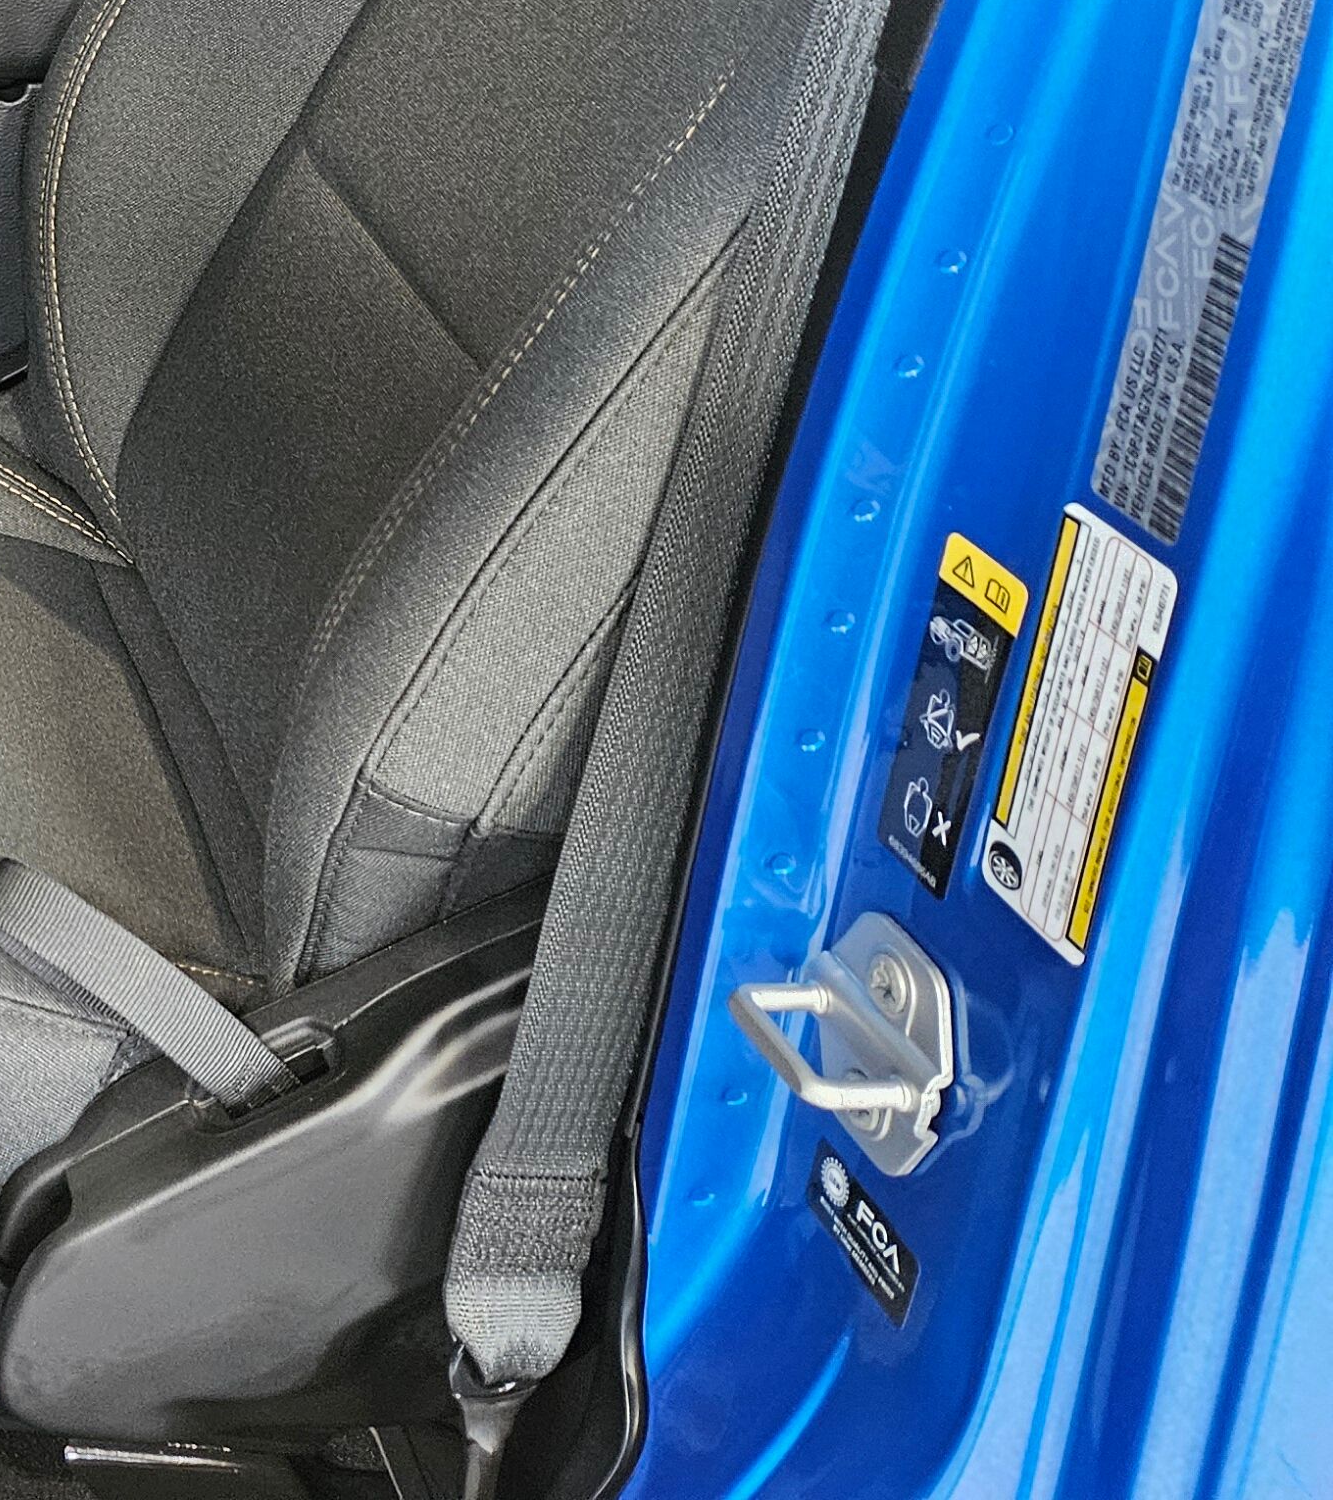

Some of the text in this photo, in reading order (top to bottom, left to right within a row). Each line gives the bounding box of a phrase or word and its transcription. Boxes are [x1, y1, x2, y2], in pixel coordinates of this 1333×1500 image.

[1251, 2, 1264, 28] COLD
[1267, 45, 1278, 63] ALL
[1263, 66, 1273, 77] TO
[1245, 160, 1260, 197] SAFETY
[1255, 135, 1267, 156] AND
[1261, 101, 1276, 132] THEFT
[1269, 34, 1292, 98] PREVENTION
[1248, 82, 1269, 137] CONFORMS
[1226, 146, 1241, 179] TRUCK
[1239, 139, 1255, 179] VEHICLE
[1232, 182, 1243, 204] THIS
[1127, 346, 1145, 373] LLC
[1122, 377, 1138, 397] US
[1114, 402, 1132, 430] FCA
[1098, 465, 1116, 497] MFD
[1129, 460, 1154, 519] VEHICLE
[1145, 413, 1166, 456] MADE
[1062, 653, 1070, 669] AND
[857, 1200, 901, 1272] FCA
[834, 1213, 846, 1235] WITH
[847, 1232, 868, 1263] QUALITY
[868, 1260, 877, 1278] AND
[878, 1276, 894, 1300] PRIDE
[851, 1250, 875, 1284] MEMBERS
